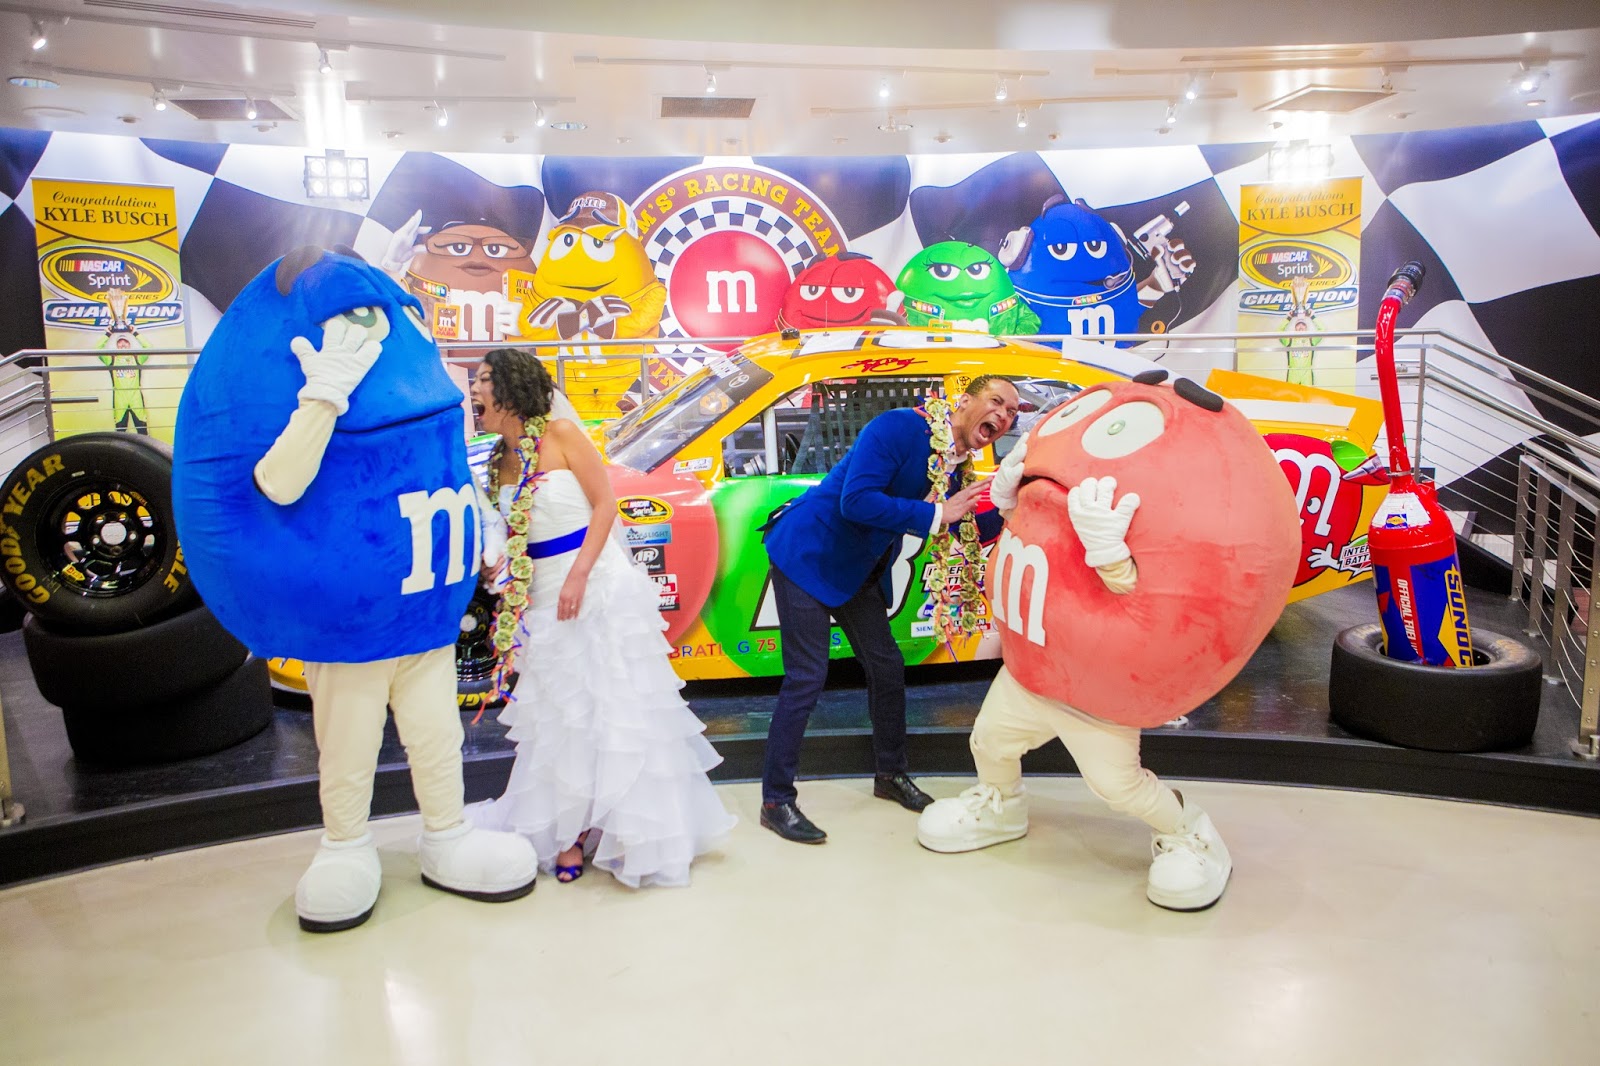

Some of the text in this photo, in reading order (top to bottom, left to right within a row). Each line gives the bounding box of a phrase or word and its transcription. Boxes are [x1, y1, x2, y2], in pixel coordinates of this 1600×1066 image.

[52, 190, 158, 209] Congratulations
[683, 173, 789, 206] RACING
[43, 206, 170, 227] KYLE BUSCH
[1247, 202, 1355, 221] KYLE BUSCH
[79, 260, 124, 272] NASCAR
[1270, 251, 1309, 263] NASCAR
[1277, 263, 1314, 277] Sprint
[88, 273, 132, 289] Sprint
[706, 270, 758, 313] m
[397, 482, 481, 595] m
[992, 527, 1049, 647] m
[1397, 578, 1412, 618] OFFICIAL
[1403, 619, 1417, 641] FUEL
[756, 638, 777, 652] 75
